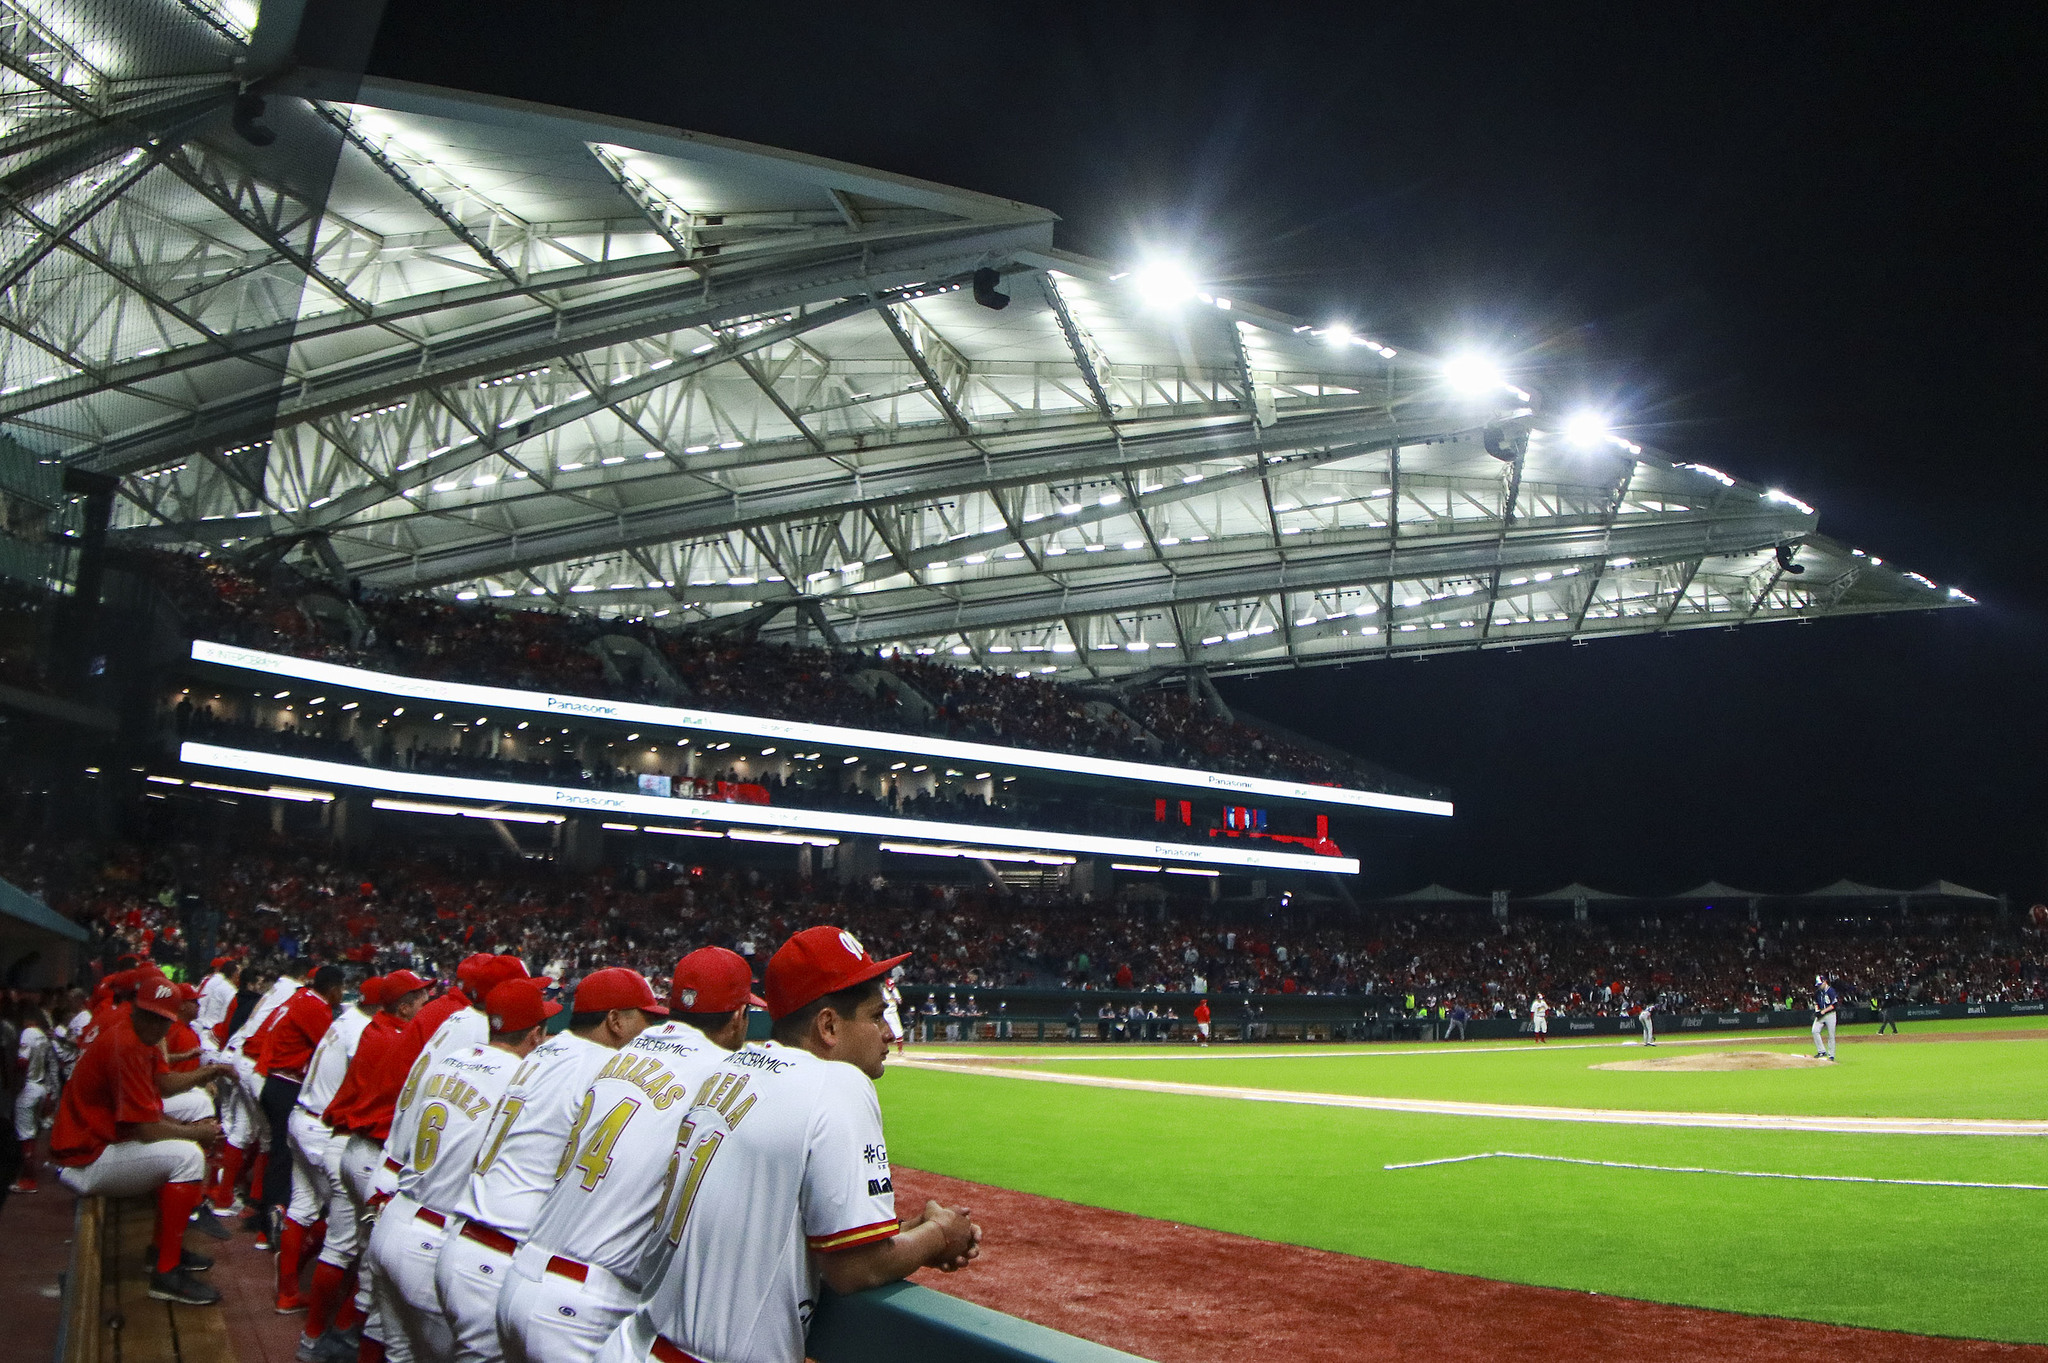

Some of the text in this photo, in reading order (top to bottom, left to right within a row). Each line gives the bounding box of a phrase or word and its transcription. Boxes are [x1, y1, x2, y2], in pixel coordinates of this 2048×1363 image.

[547, 697, 618, 717] Panasonic
[1208, 775, 1254, 789] Panasonic
[555, 791, 625, 808] Panasonic
[1155, 845, 1202, 857] Panasonic
[1569, 1021, 1595, 1030] Panasonic
[413, 1102, 449, 1175] 6
